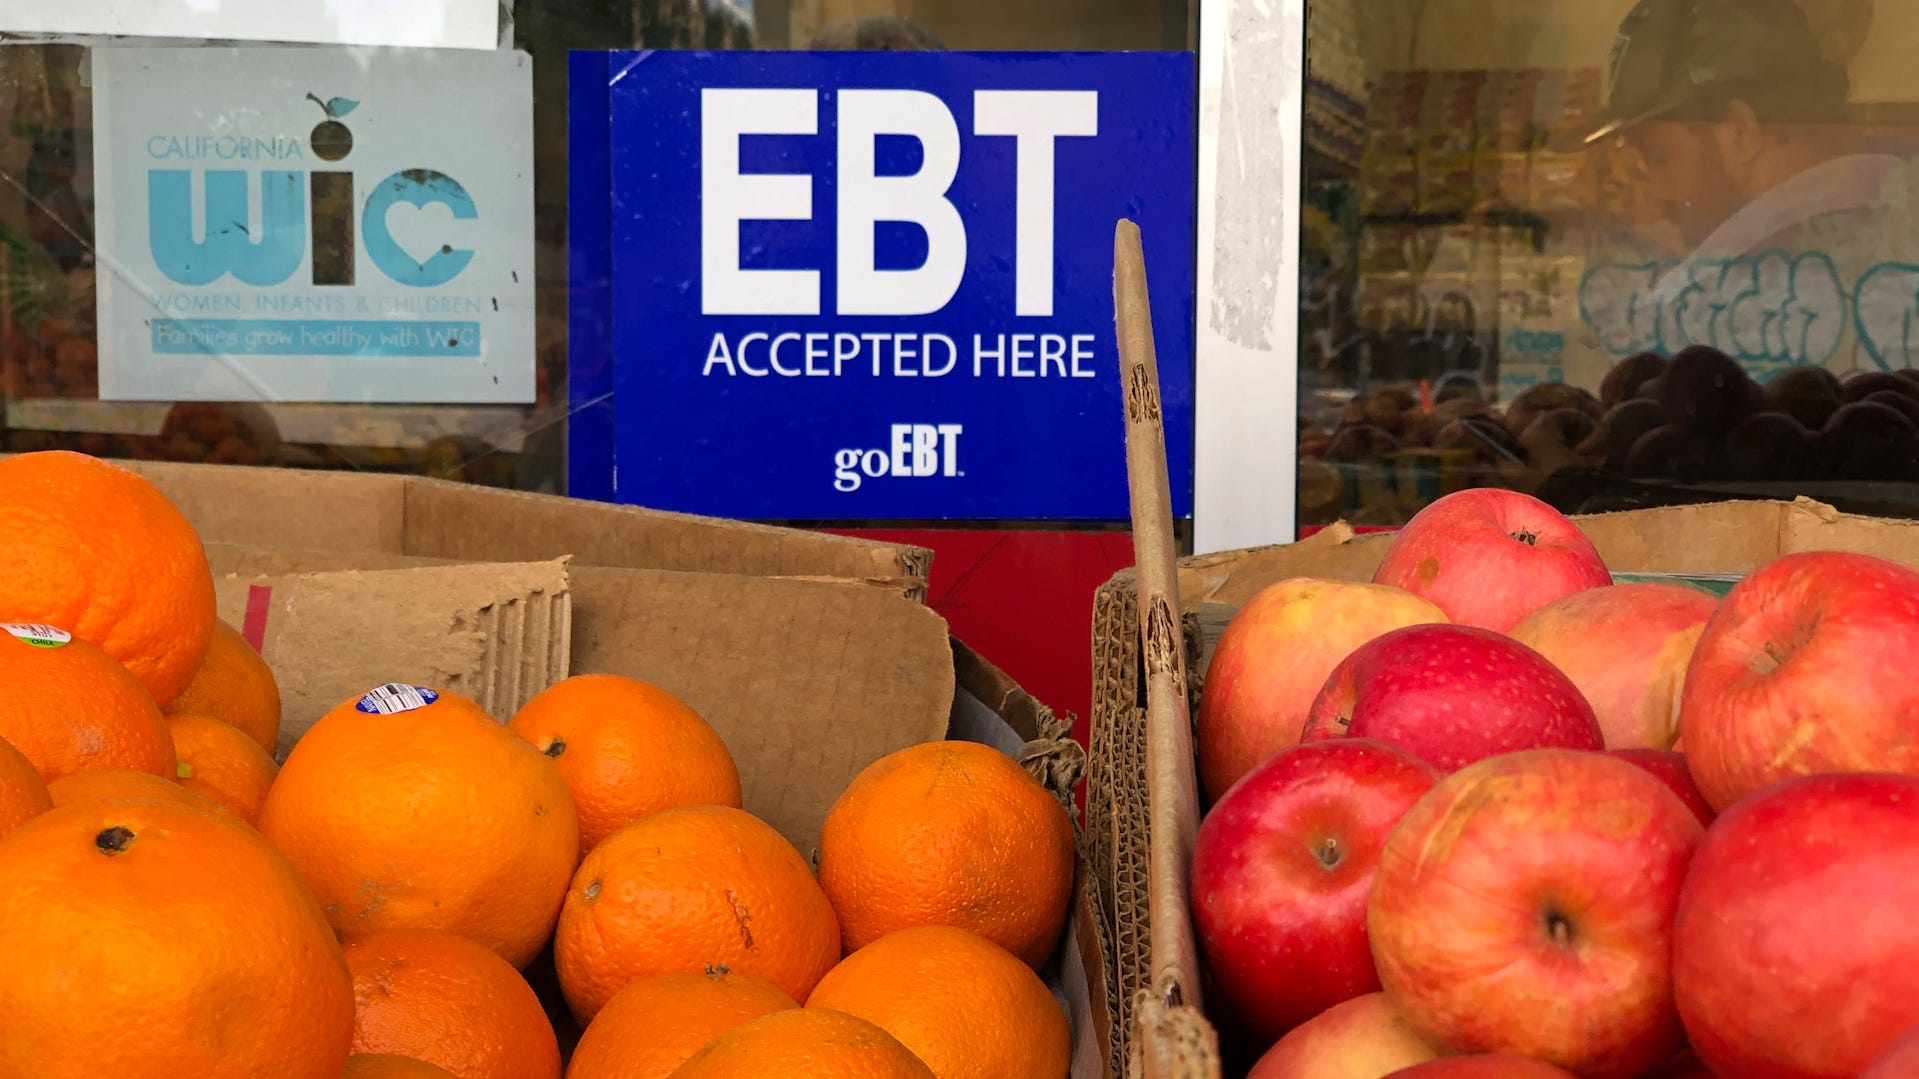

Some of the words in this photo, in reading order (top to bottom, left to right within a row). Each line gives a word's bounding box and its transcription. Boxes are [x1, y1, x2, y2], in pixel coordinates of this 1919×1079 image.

[147, 135, 303, 160] CALIFORNIA
[701, 88, 1098, 317] EBT
[256, 294, 346, 312] INFANTS
[356, 296, 369, 312] &
[381, 295, 481, 313] CHILDREN
[158, 321, 238, 345] Families
[245, 329, 293, 351] grow
[301, 325, 371, 351] healthy
[379, 326, 418, 346] with
[426, 327, 474, 348] WIC
[702, 333, 957, 377] ACCEPTED
[974, 334, 1096, 378] HERE
